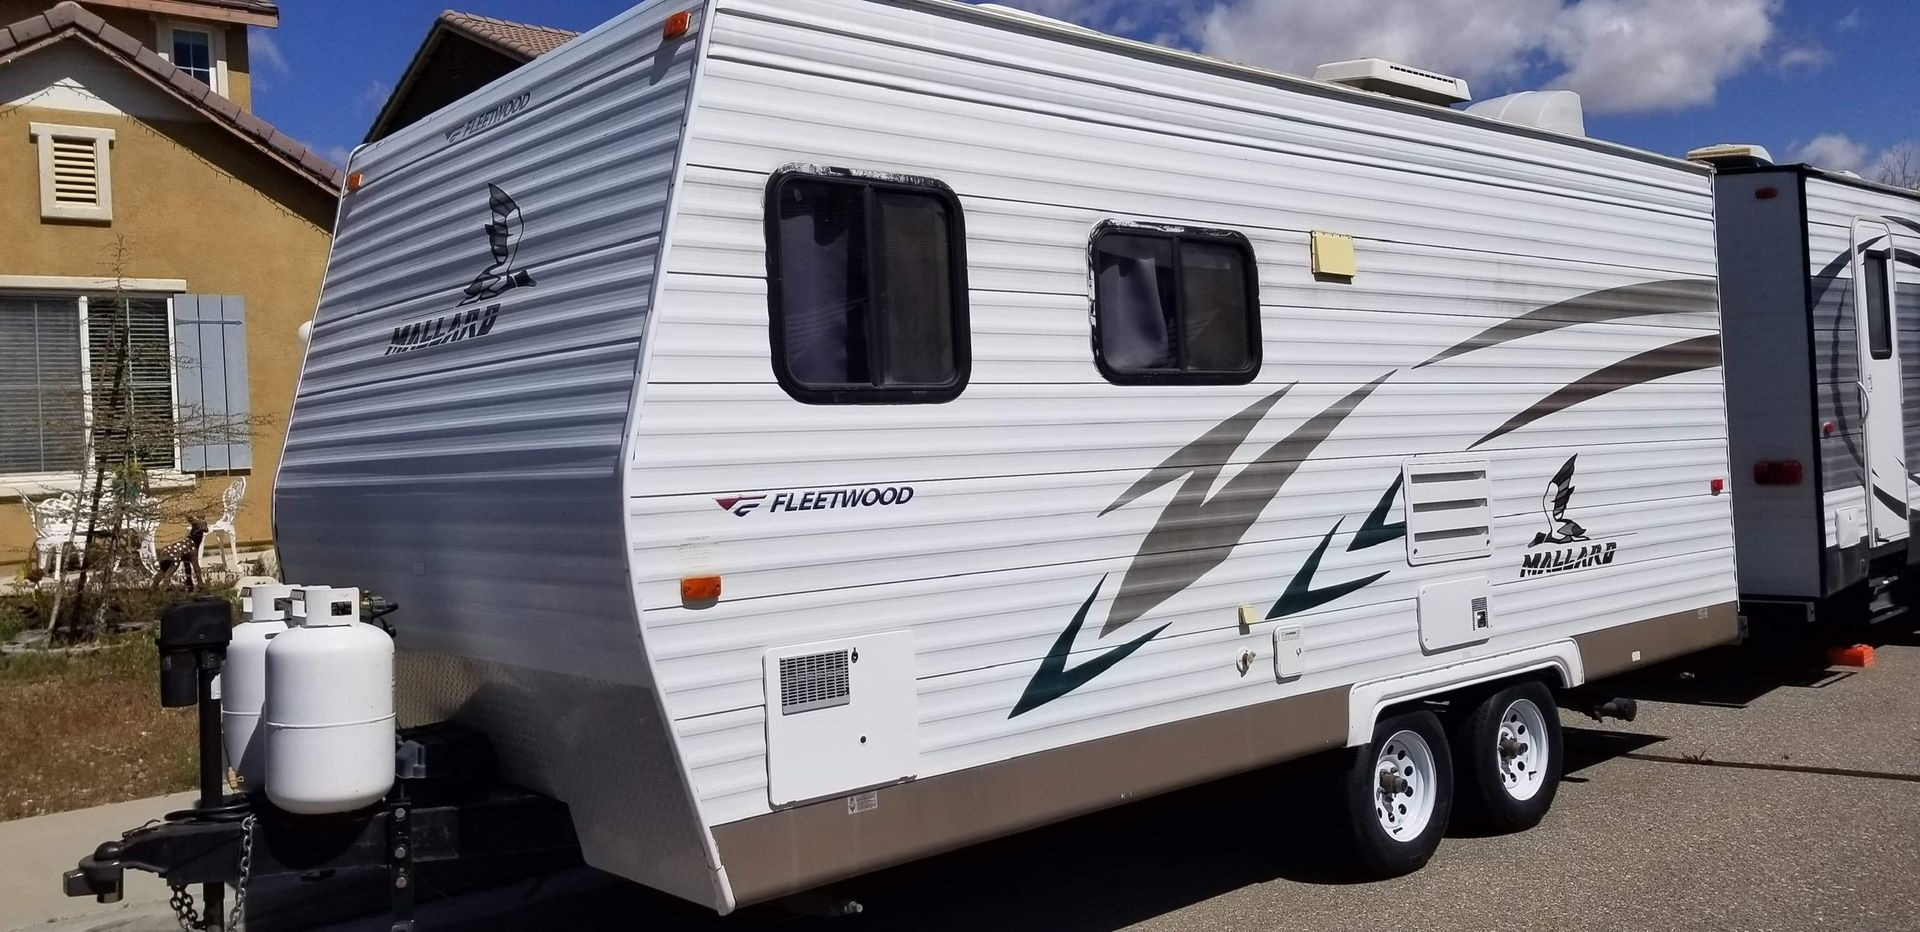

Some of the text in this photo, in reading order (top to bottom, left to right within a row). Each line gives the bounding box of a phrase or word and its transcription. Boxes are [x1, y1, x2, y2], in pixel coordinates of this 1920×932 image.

[463, 91, 531, 137] FLEETWOOD
[384, 303, 501, 356] MALLARD
[770, 486, 914, 512] FLEETWOOD
[1520, 542, 1617, 577] MALLARD
